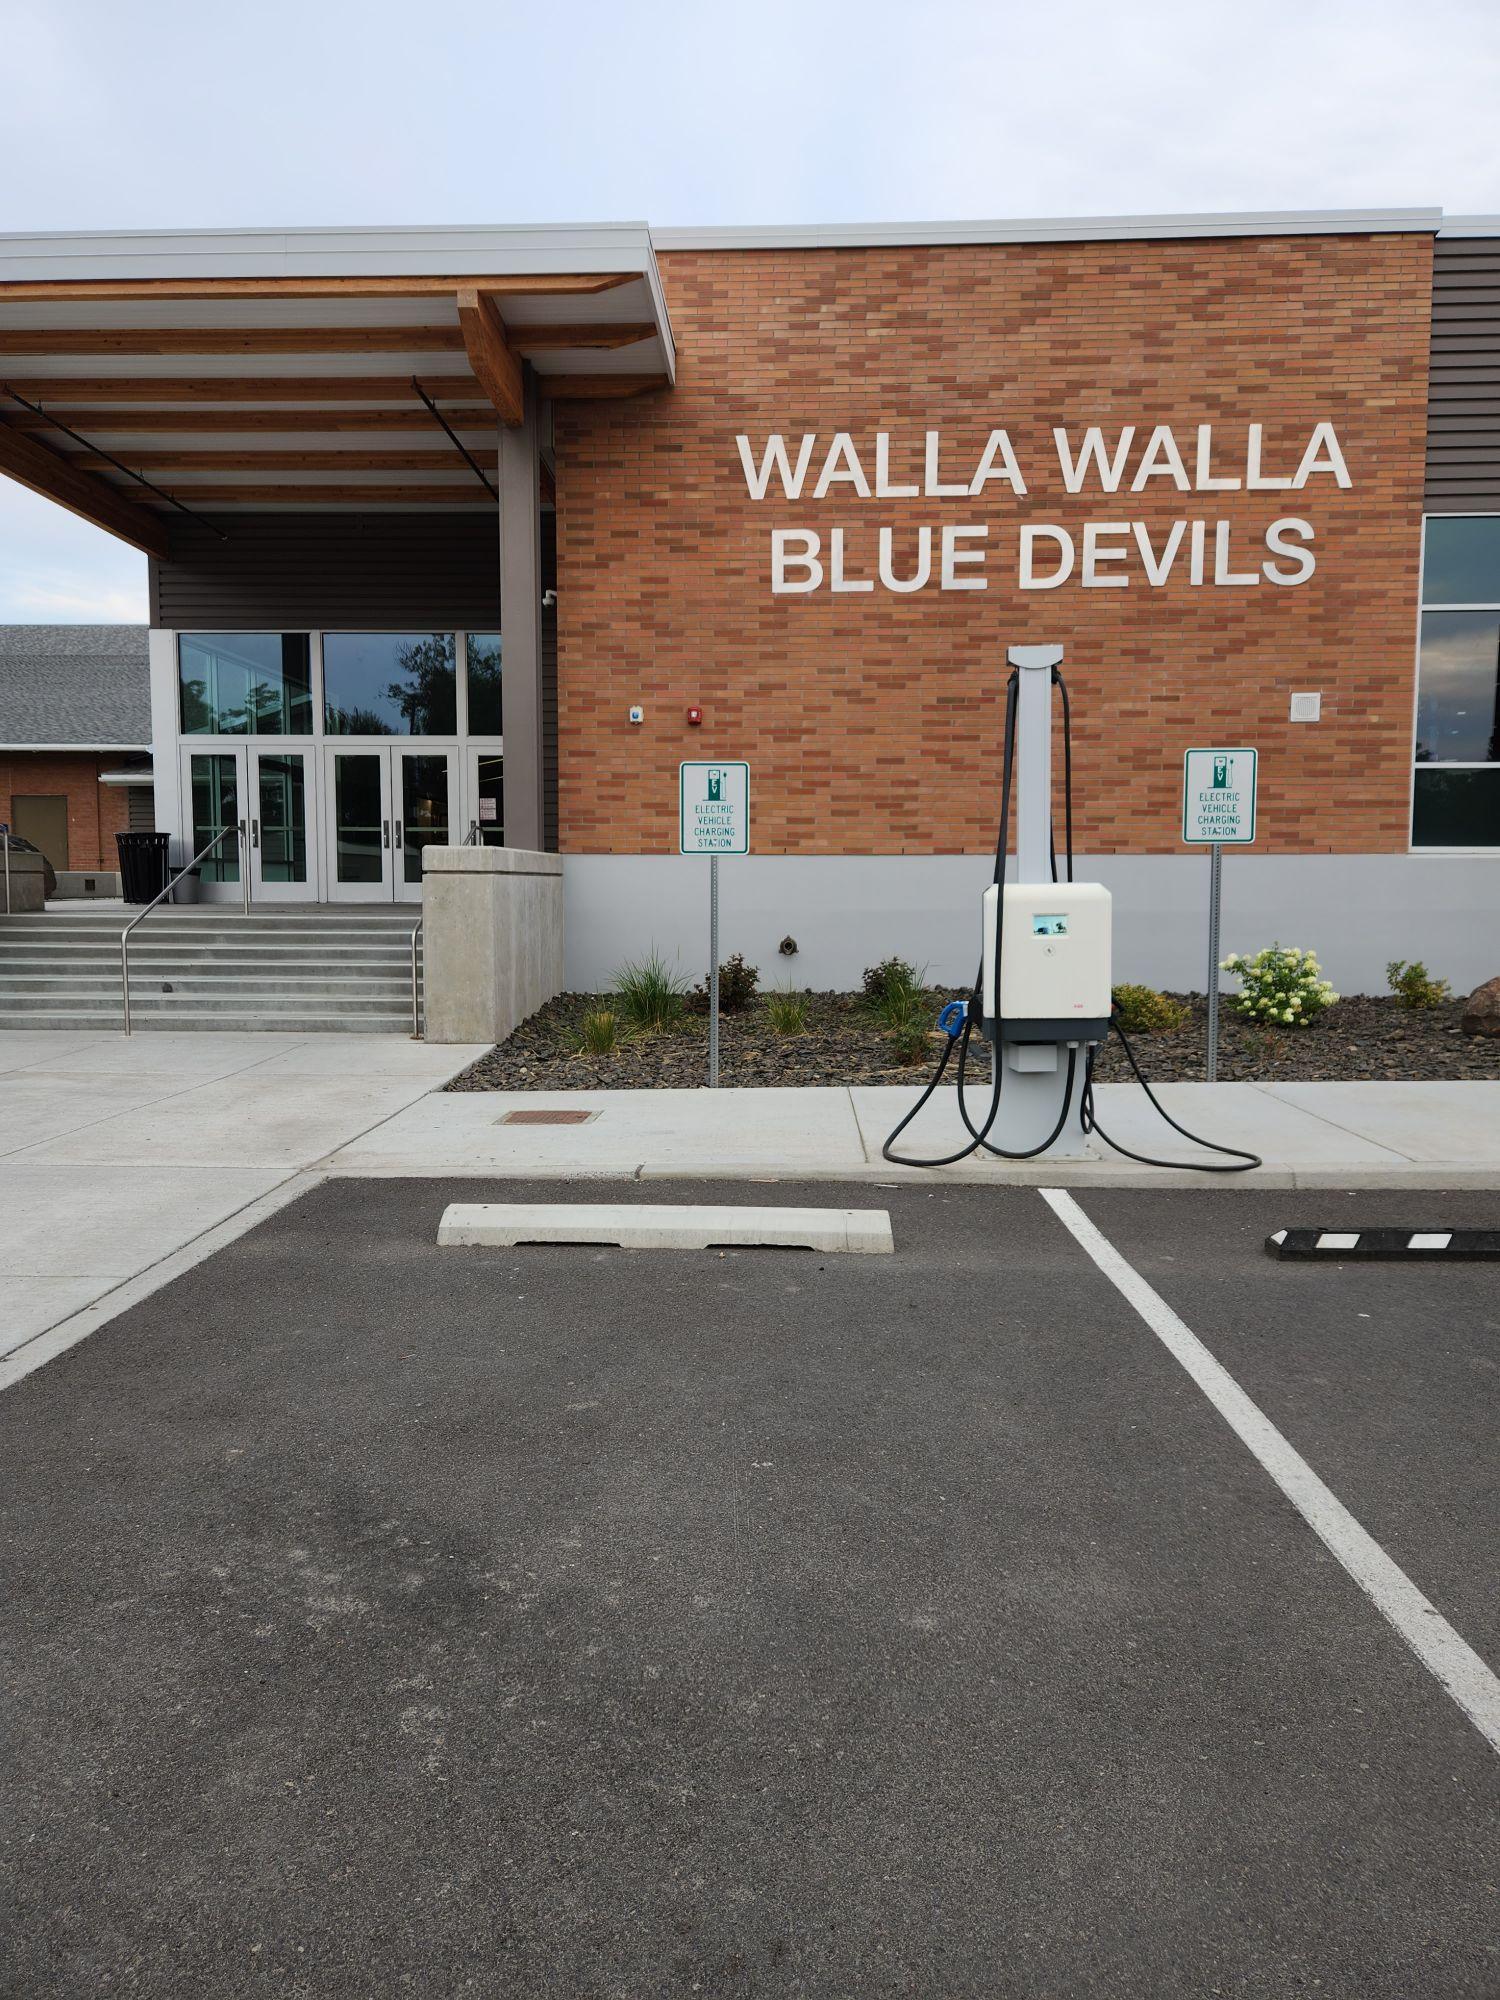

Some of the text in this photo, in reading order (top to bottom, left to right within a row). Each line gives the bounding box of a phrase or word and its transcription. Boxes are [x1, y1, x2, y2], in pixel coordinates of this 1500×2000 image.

[736, 422, 1353, 500] WALLA WALLA
[771, 517, 1317, 594] BLUE DEVILS
[1199, 792, 1240, 802] ELECTRIC
[695, 805, 734, 814] ELECTRIC
[1202, 804, 1237, 813] VEHICLE
[698, 816, 732, 825] VEHICLE
[1197, 815, 1241, 825] CHARGING
[694, 827, 735, 836] CHARGING
